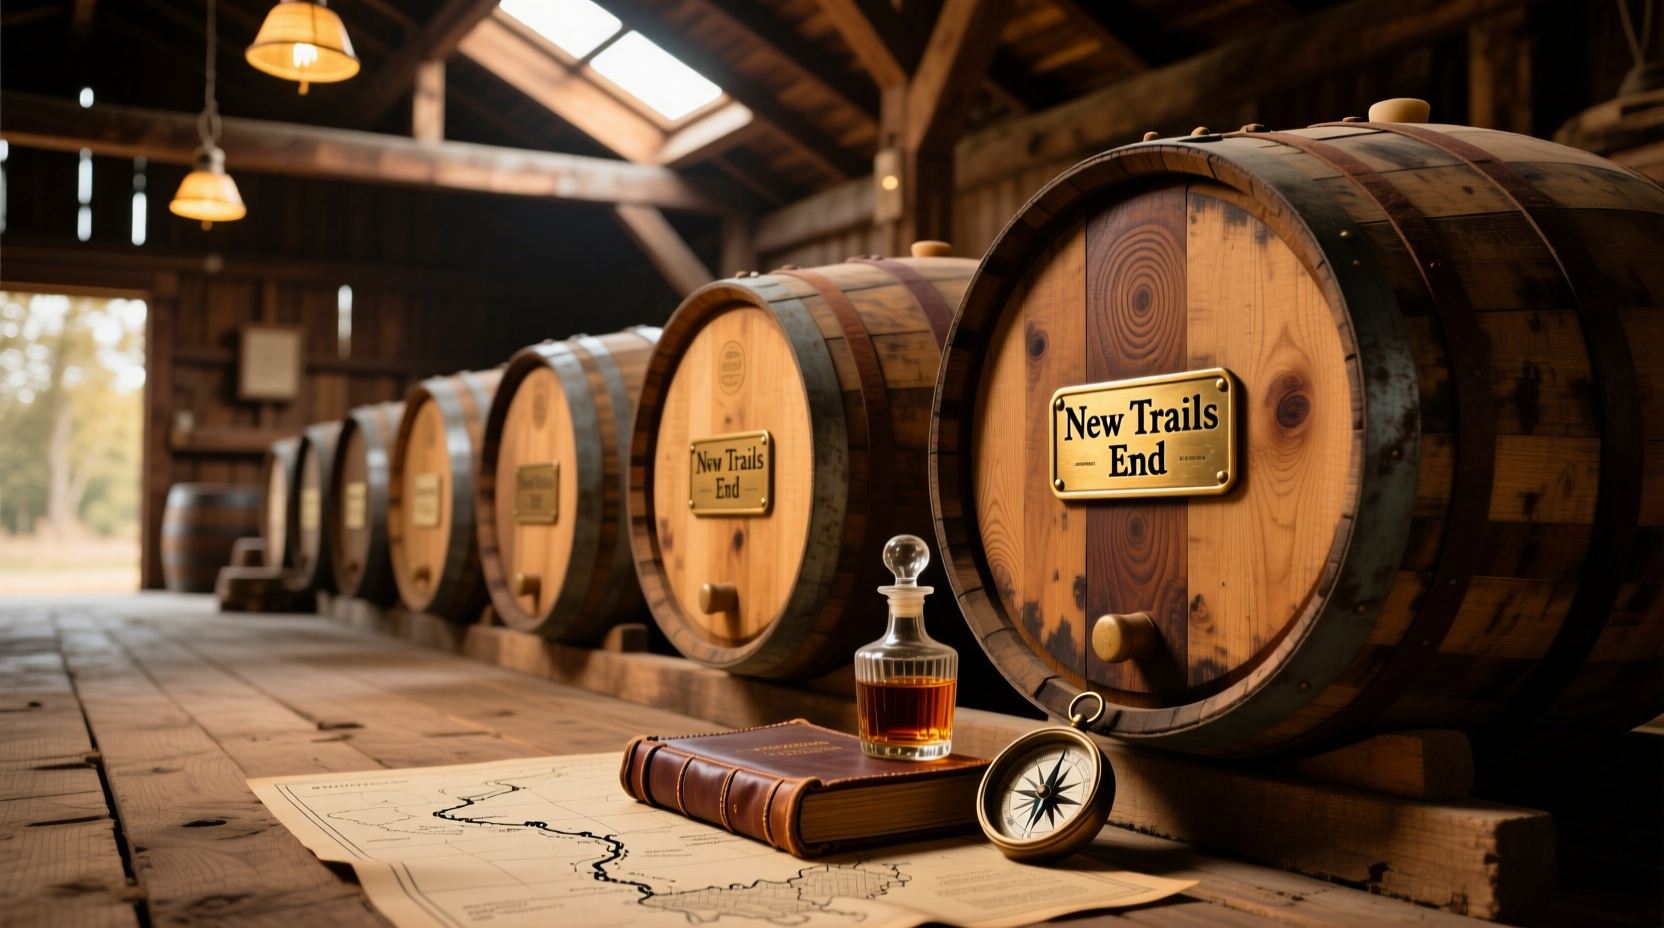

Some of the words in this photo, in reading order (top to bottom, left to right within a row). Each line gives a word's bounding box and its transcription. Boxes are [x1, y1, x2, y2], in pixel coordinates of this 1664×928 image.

[1064, 405, 1125, 441] New
[1129, 393, 1219, 435] Trails
[696, 450, 722, 475] New
[725, 445, 764, 471] Trails
[1108, 440, 1168, 478] End
[716, 475, 740, 499] End
